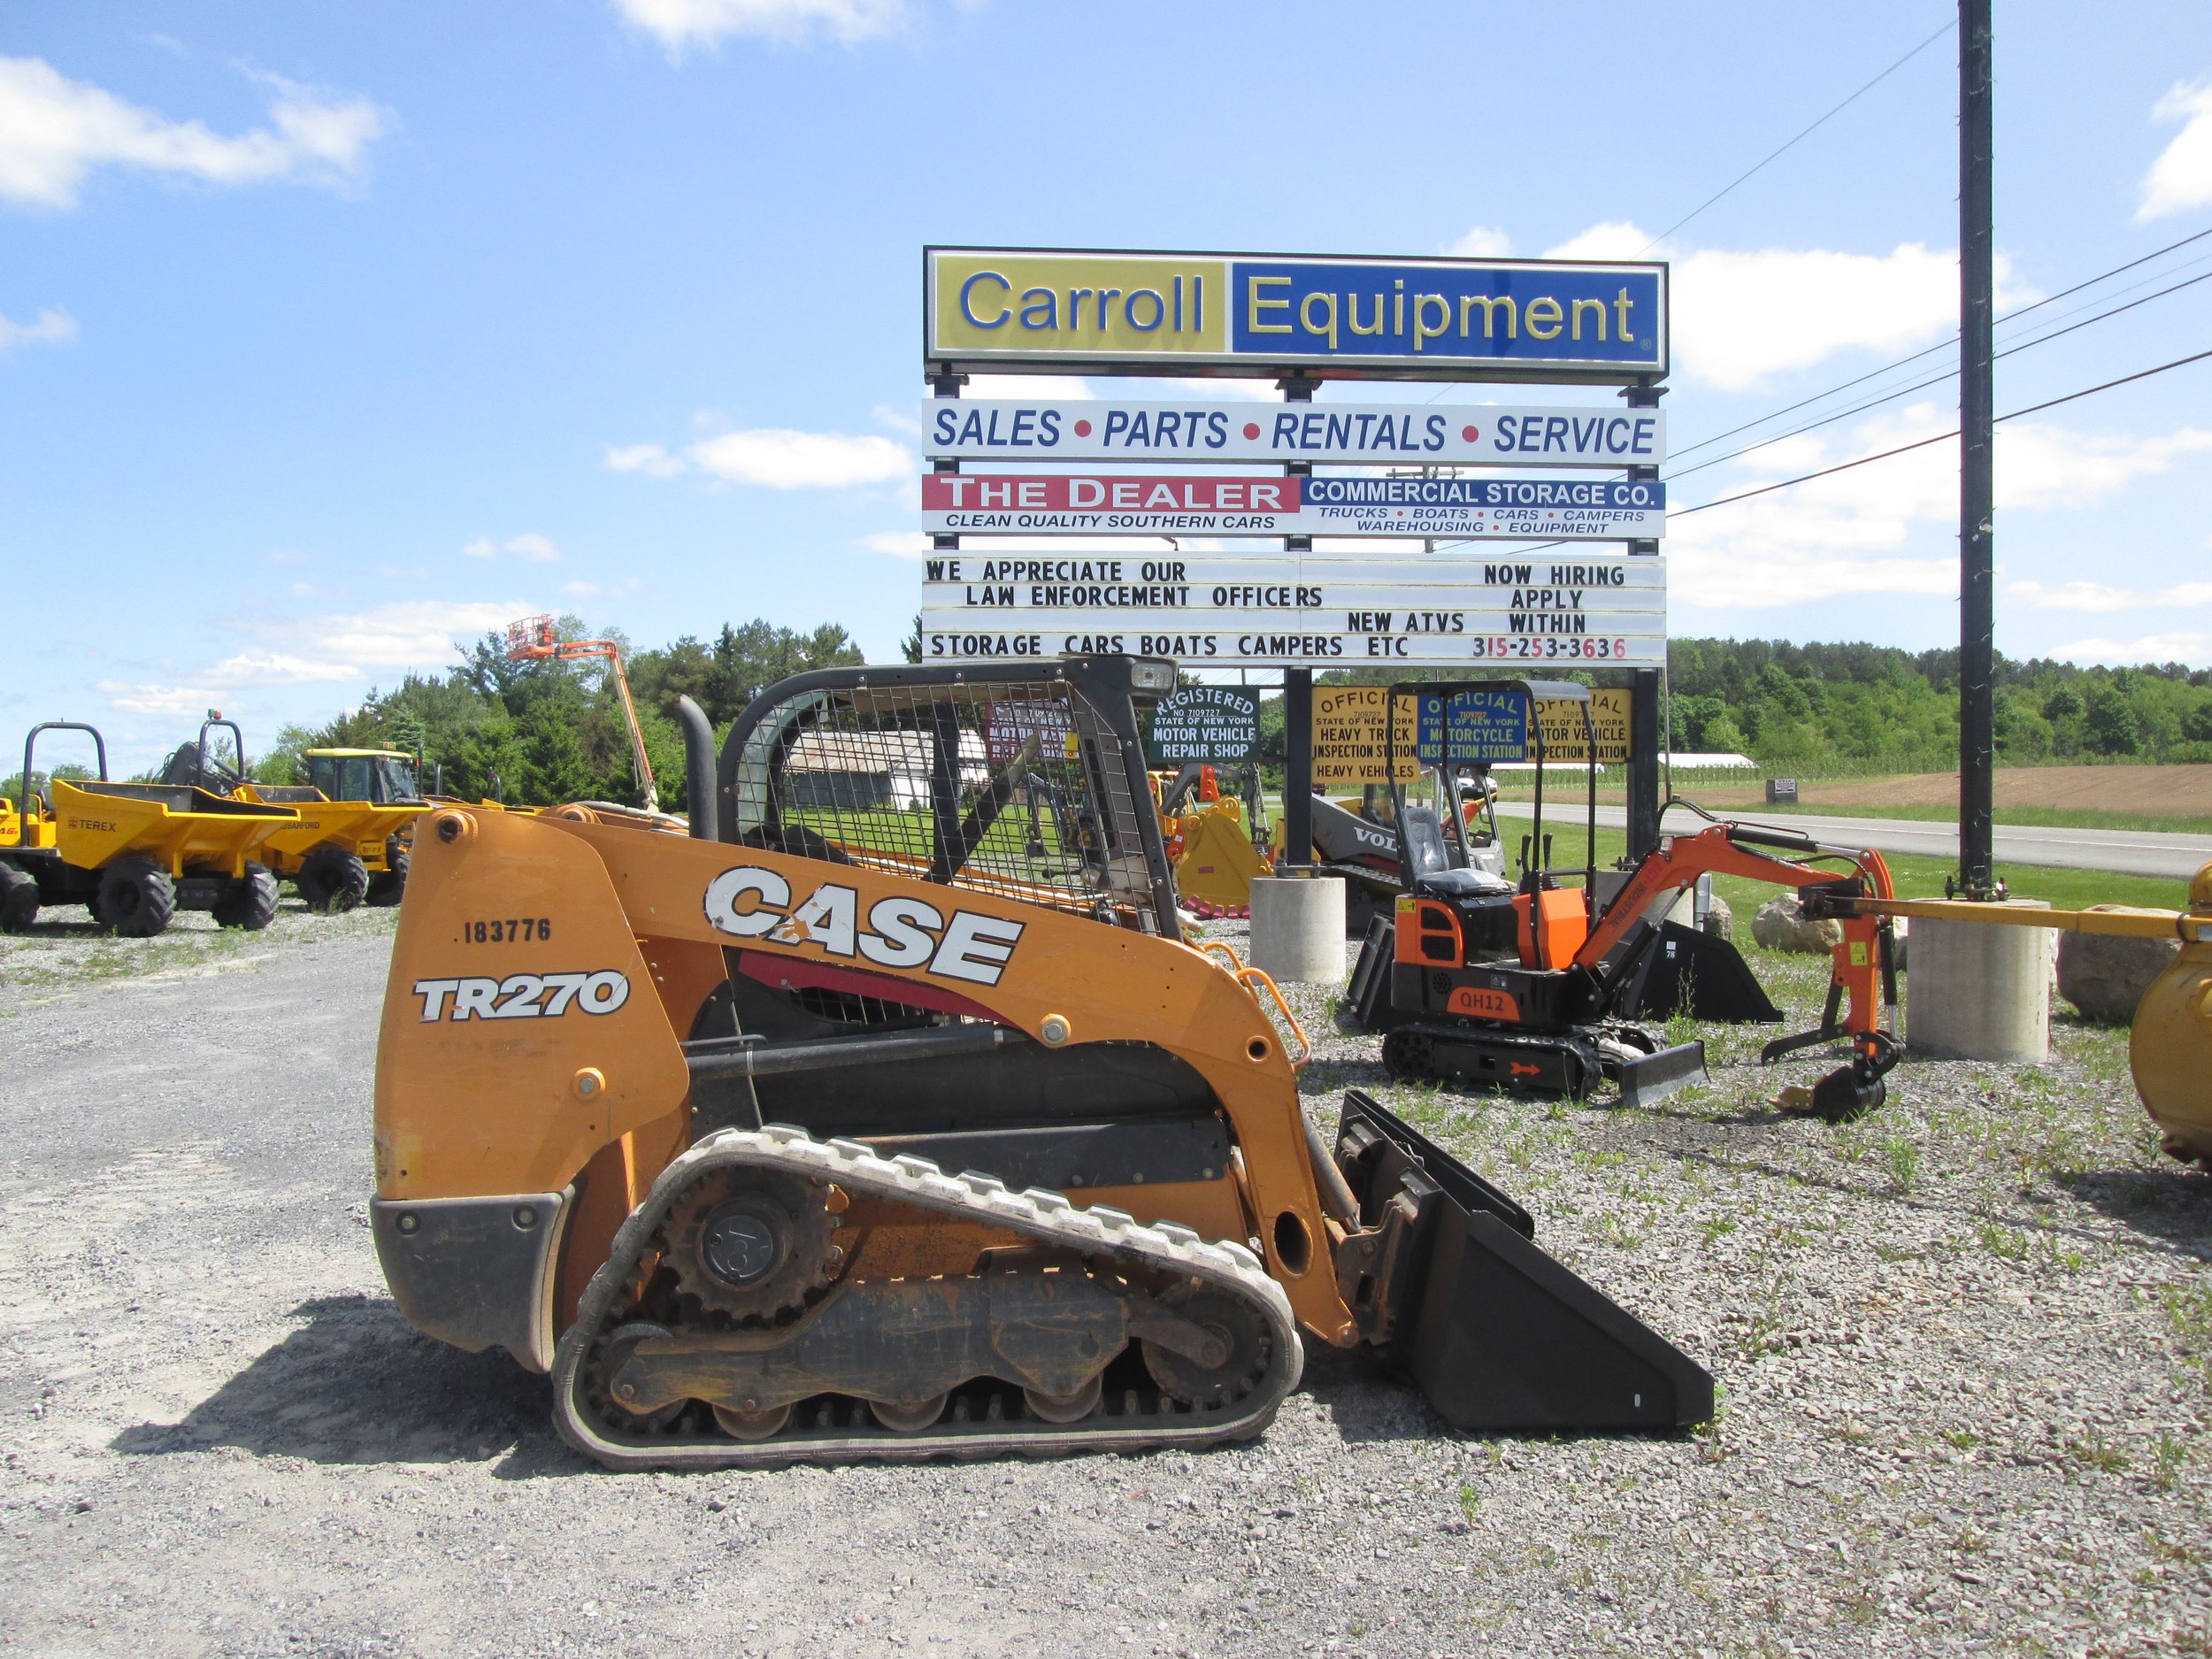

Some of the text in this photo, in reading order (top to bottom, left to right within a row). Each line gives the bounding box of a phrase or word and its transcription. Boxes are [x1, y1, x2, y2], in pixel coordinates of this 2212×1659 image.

[959, 271, 1634, 352] Carroll Equipment
[933, 408, 1656, 455] SALES PARTS RENTALS SERVICE
[940, 477, 1284, 510] THE DEALER
[1308, 480, 1656, 506] COMMERCIAL STORAGE CO.
[945, 514, 1275, 529] CLEAN QUALITY SOUTHERN CARS
[1319, 507, 1646, 522] TRUCKS BOATS CARS CAMPERS
[1356, 520, 1609, 534] WAREHOUSING EQUIPMENT
[926, 561, 1187, 582] WE APPRECIATE OUR
[1484, 565, 1624, 586] NOW HIRING
[965, 586, 1323, 607] LAW ENFORCEMENT OFFICERS
[1510, 589, 1583, 610] APPLY
[1348, 612, 1464, 633] NEW ATVS
[1509, 613, 1586, 634] WITHIN
[932, 634, 1409, 657] STORAGE CARS BOATS CAMPERS ETC
[1472, 637, 1626, 658] 315-253-3636
[1156, 688, 1254, 716] REGISTERED
[1321, 691, 1411, 713] OFFICIAL
[1428, 692, 1517, 714] OFICIAL
[1535, 694, 1622, 714] OFIAL
[1153, 727, 1256, 741] MOTOR VEHICLE
[1320, 728, 1361, 741] HEAVY
[1163, 744, 1249, 757] REPAIR SHOP
[1314, 745, 1417, 757] INSPECTION STTION
[1482, 745, 1523, 758] STATION
[1526, 745, 1584, 758] INPECTION
[1317, 765, 1353, 777] HEAVY
[80, 819, 117, 832] TEREX
[1354, 826, 1398, 852] VOL
[465, 918, 551, 944] 183776
[703, 864, 1026, 987] CASE
[413, 968, 631, 1024] TR270
[1460, 992, 1504, 1010] QH12
